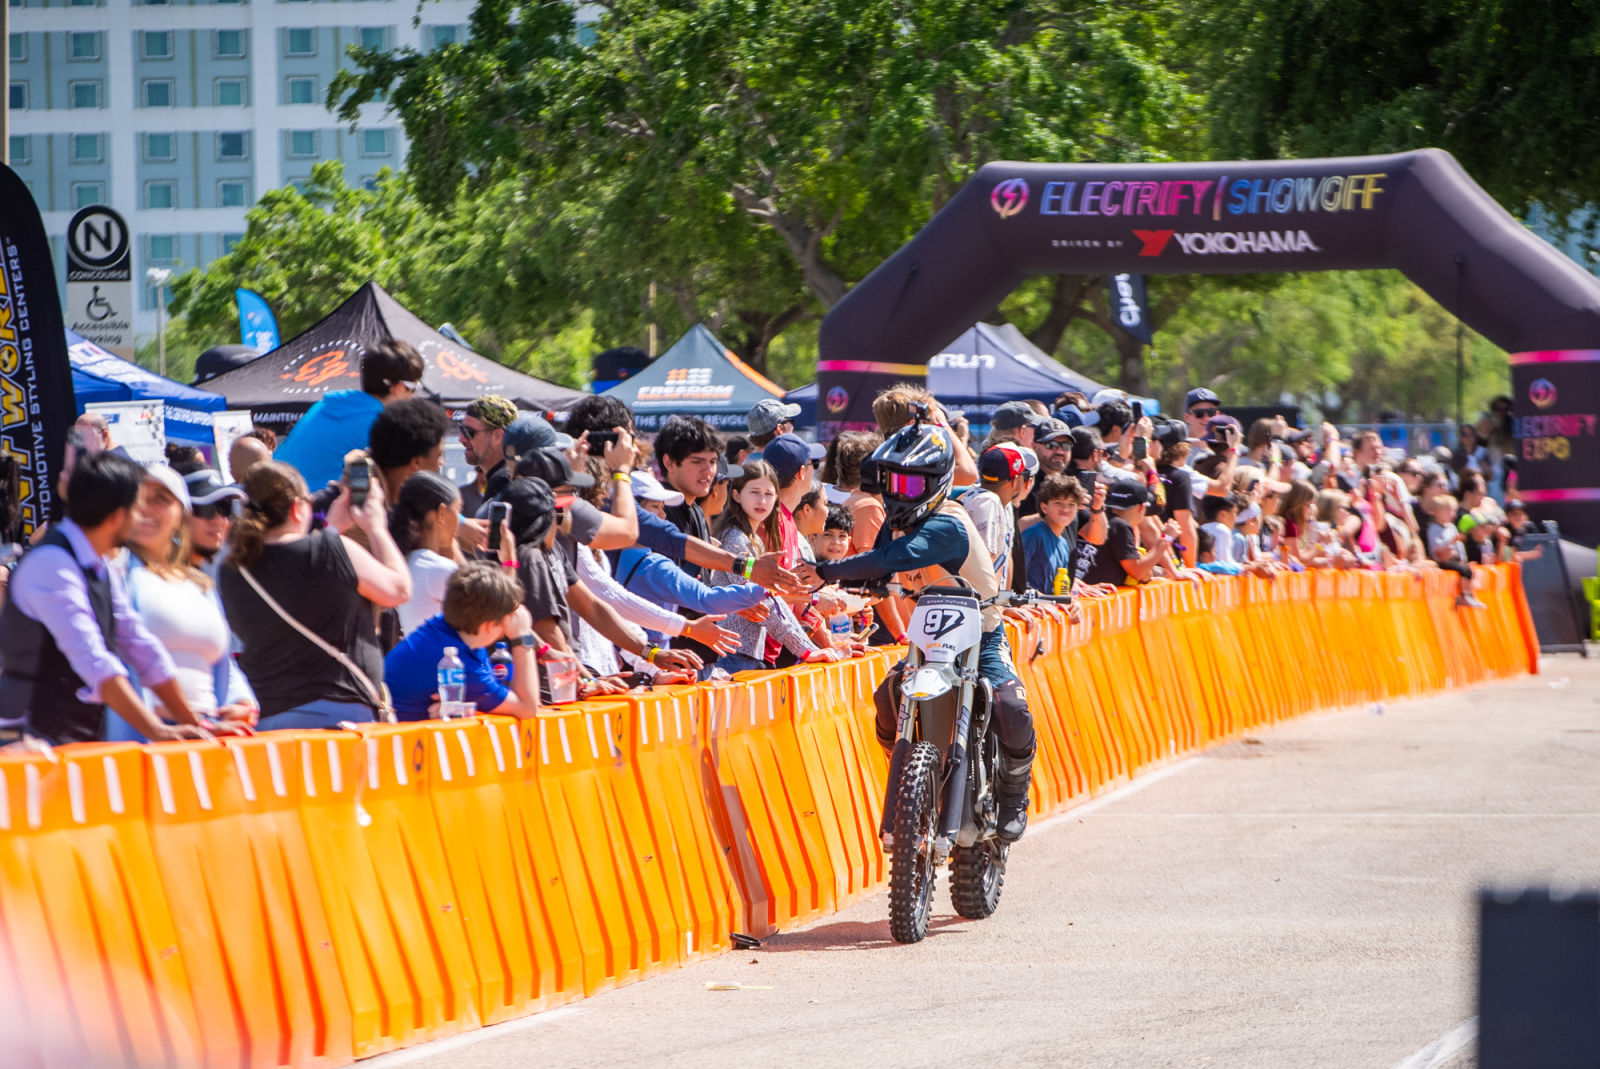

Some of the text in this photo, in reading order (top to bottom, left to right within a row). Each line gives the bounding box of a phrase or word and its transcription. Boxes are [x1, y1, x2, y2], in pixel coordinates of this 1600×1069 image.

[1039, 173, 1388, 216] ELECTRIFY SHOWOFF
[83, 220, 113, 253] N
[1173, 229, 1321, 255] YOKOHAMA
[68, 268, 130, 281] CONCOURSE
[22, 337, 41, 416] STYLING
[637, 385, 736, 396] FREEDOM
[923, 608, 965, 640] 97
